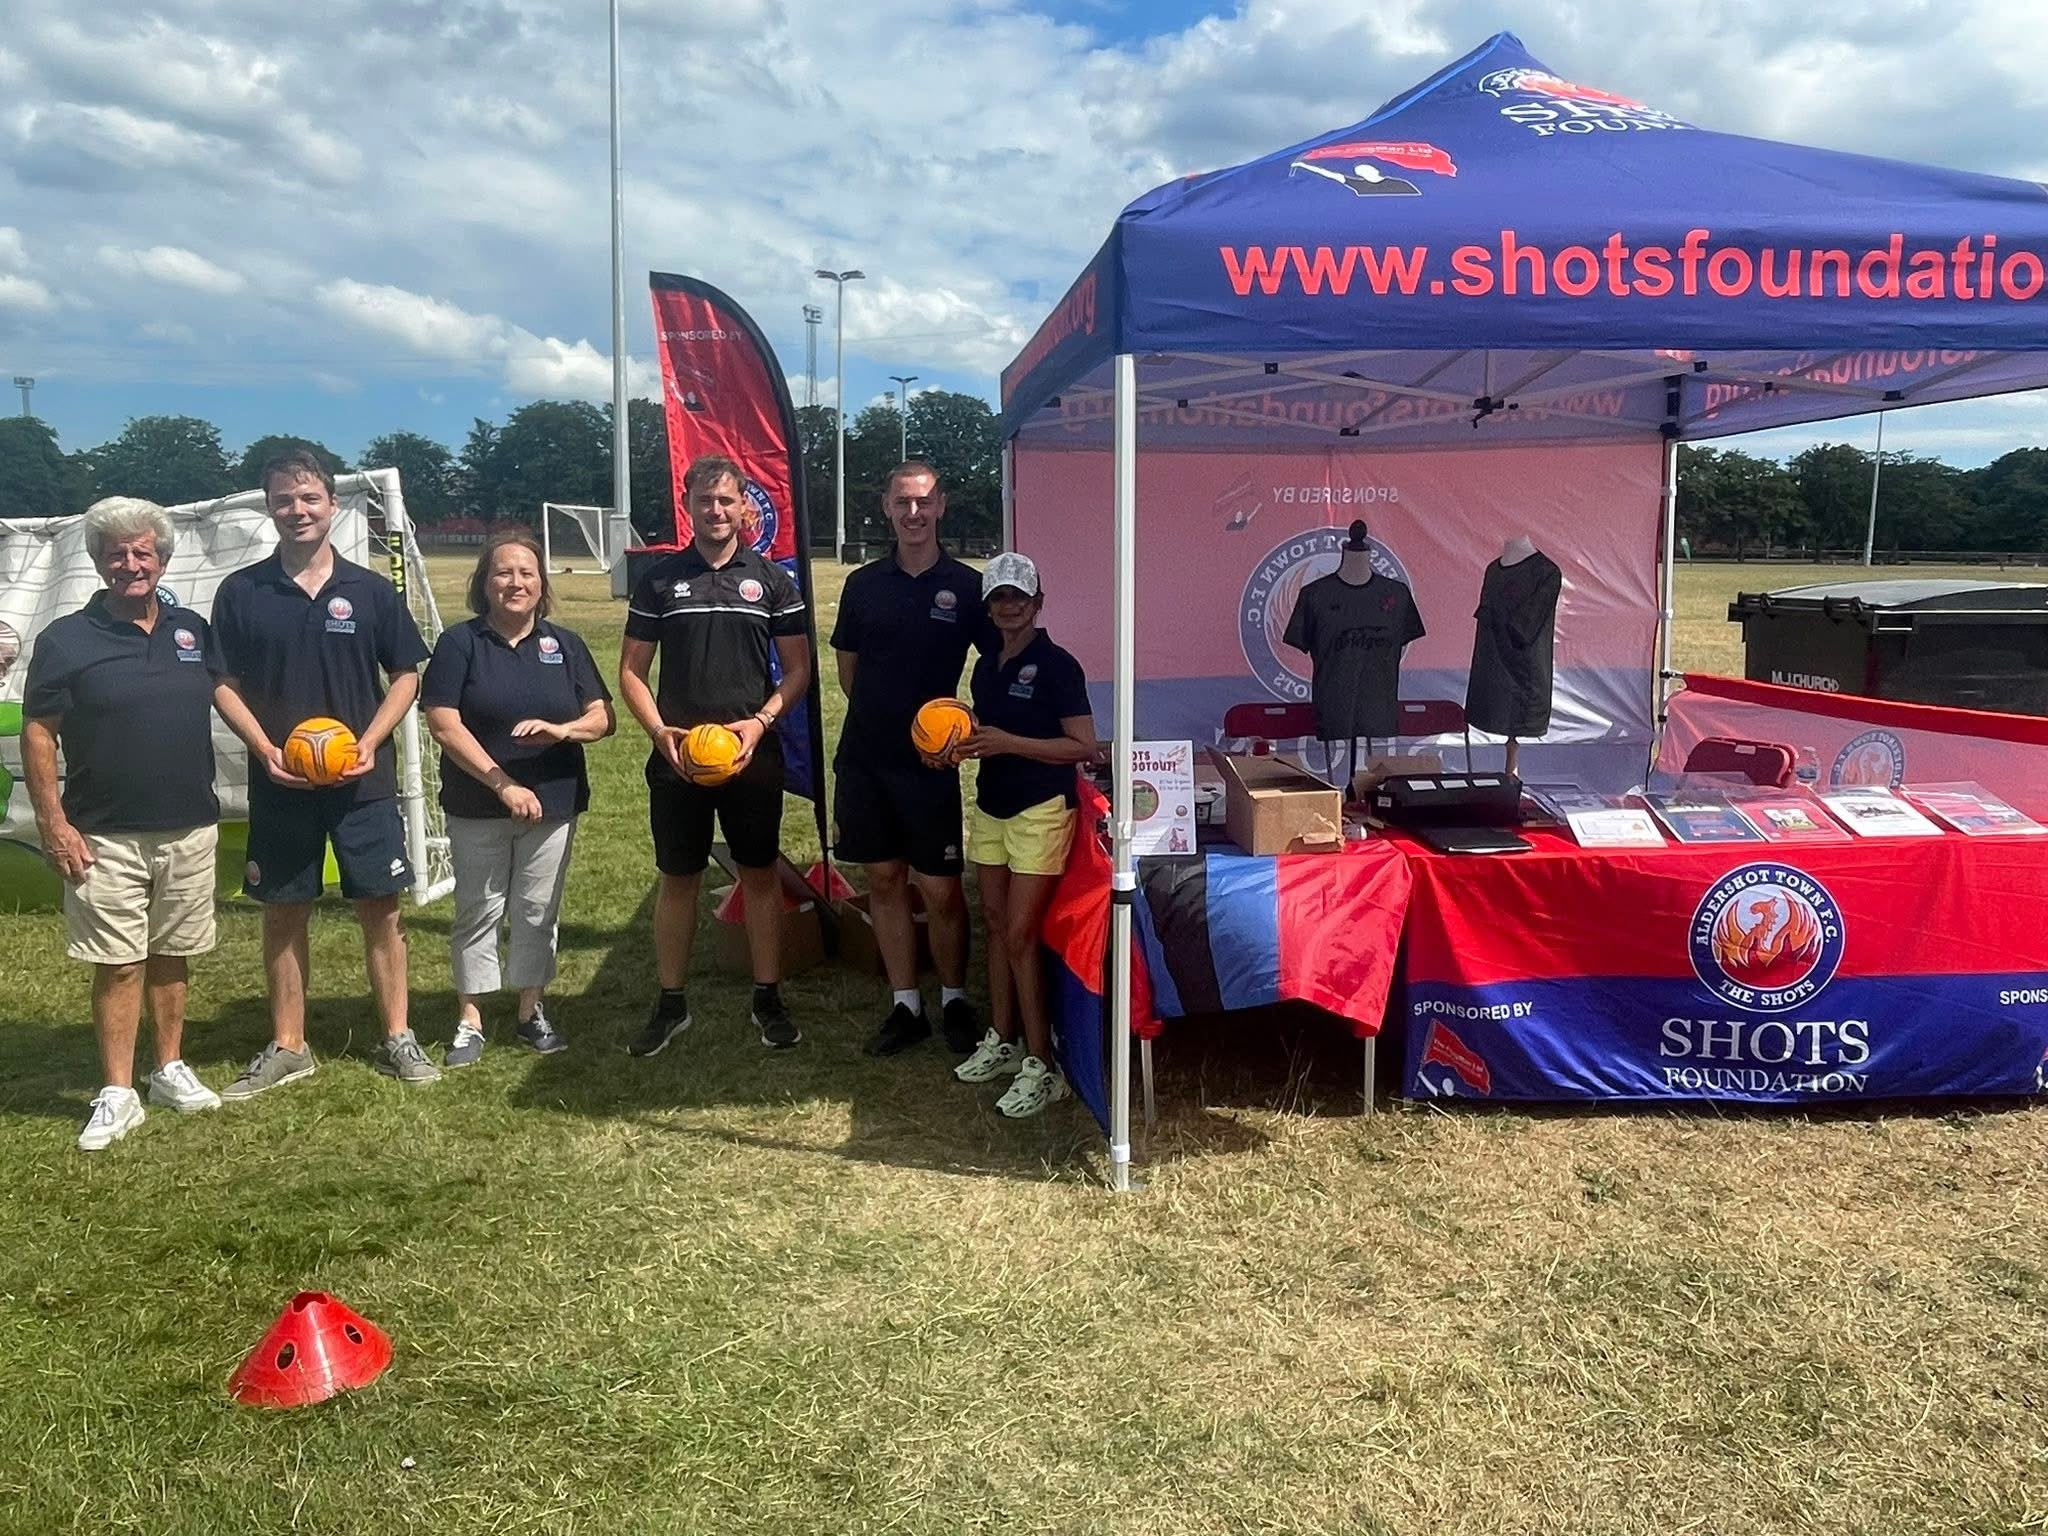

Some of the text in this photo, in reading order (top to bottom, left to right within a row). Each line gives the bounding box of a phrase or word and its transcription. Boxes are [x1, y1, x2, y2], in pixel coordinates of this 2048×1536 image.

[1219, 229, 2045, 300] www.shotsfoundatio
[1133, 751, 1151, 760] OTS
[1133, 761, 1177, 774] OOTOUT!
[1696, 869, 1838, 946] ALDERSHOT TOWN F.C.
[1720, 980, 1815, 1006] THE SHOTS
[1413, 1001, 1533, 1020] SPONSORED BY
[1660, 1017, 1870, 1065] SHOTS
[1662, 1066, 1870, 1094] FOUNDATION
